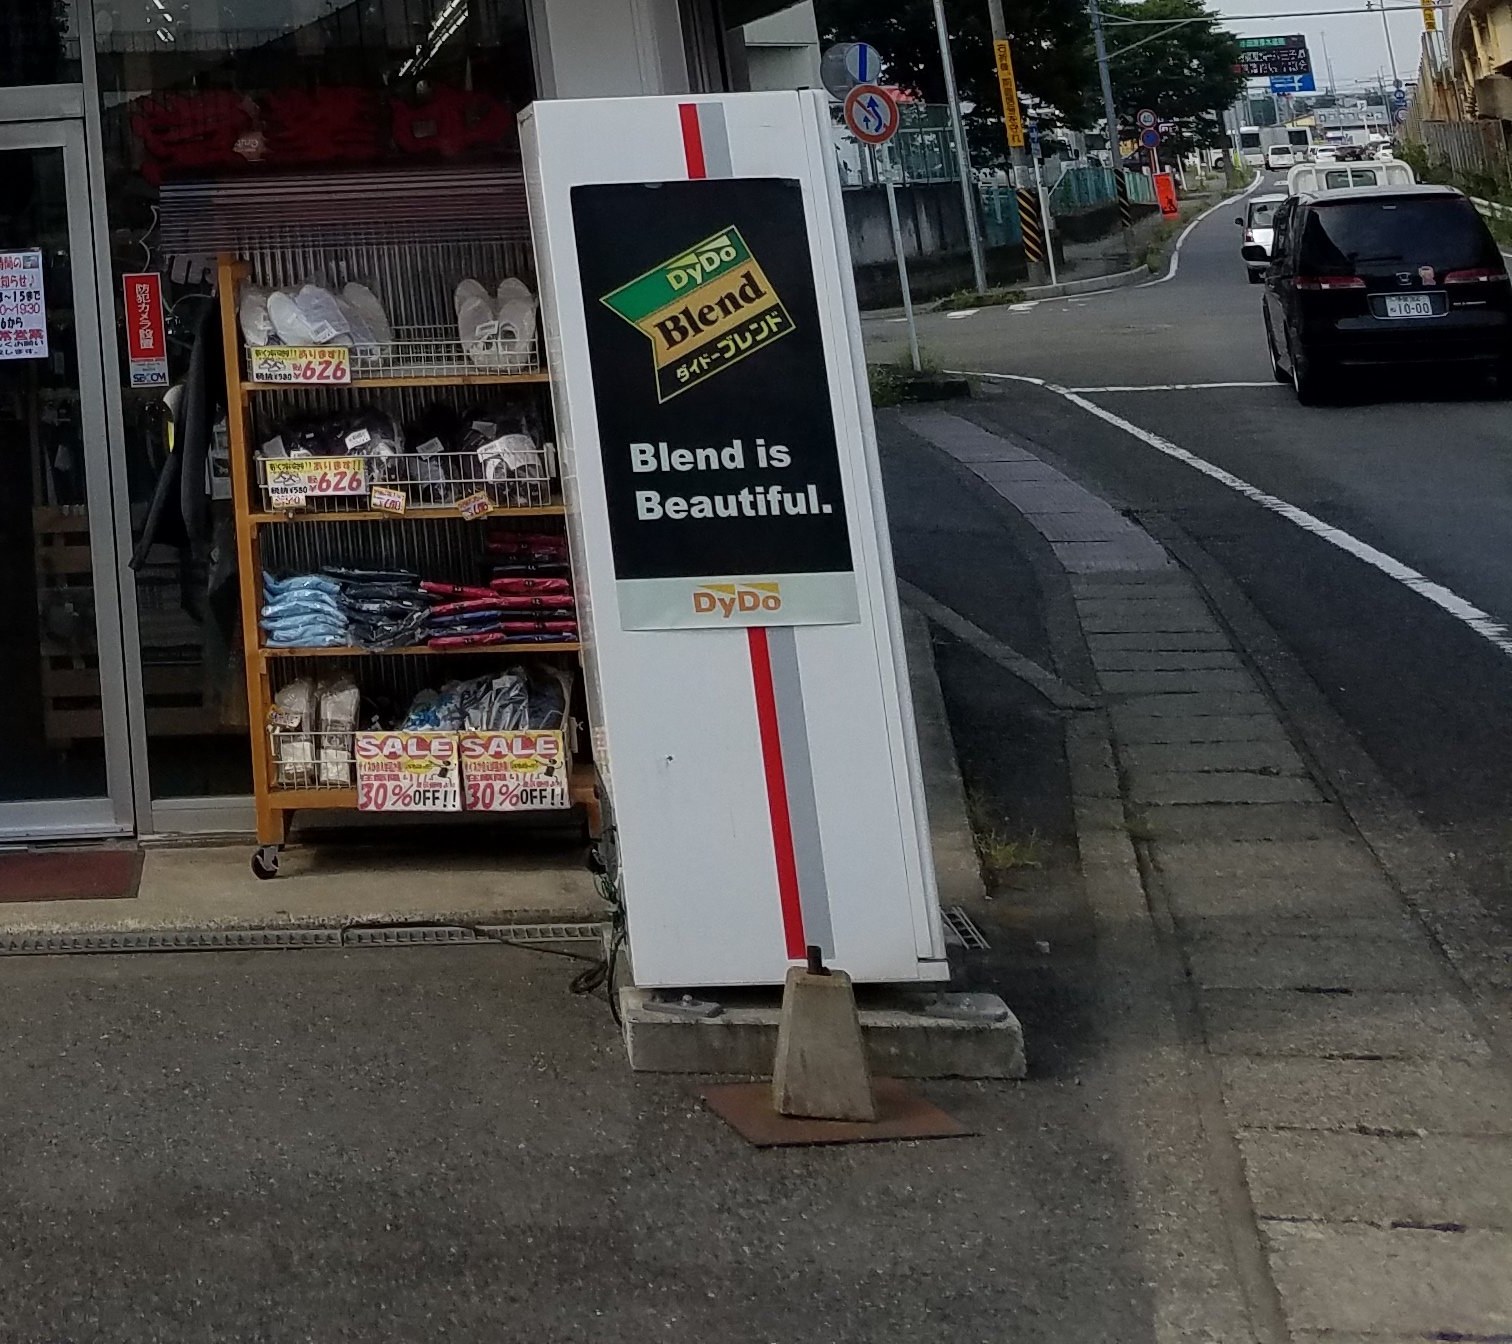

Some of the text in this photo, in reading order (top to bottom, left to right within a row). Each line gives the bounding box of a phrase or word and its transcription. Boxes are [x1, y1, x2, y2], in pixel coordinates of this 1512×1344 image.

[666, 234, 737, 291] DyDo
[135, 283, 154, 349] 防犯カメラ設置
[652, 270, 767, 351] Blend
[676, 311, 784, 383] ダイドーブレンド
[132, 373, 167, 383] SECOM
[629, 439, 792, 473] Blend is
[635, 484, 833, 521] Beautiful.
[693, 582, 782, 618] DyDo
[359, 737, 452, 756] SALE
[463, 736, 559, 756] SALE
